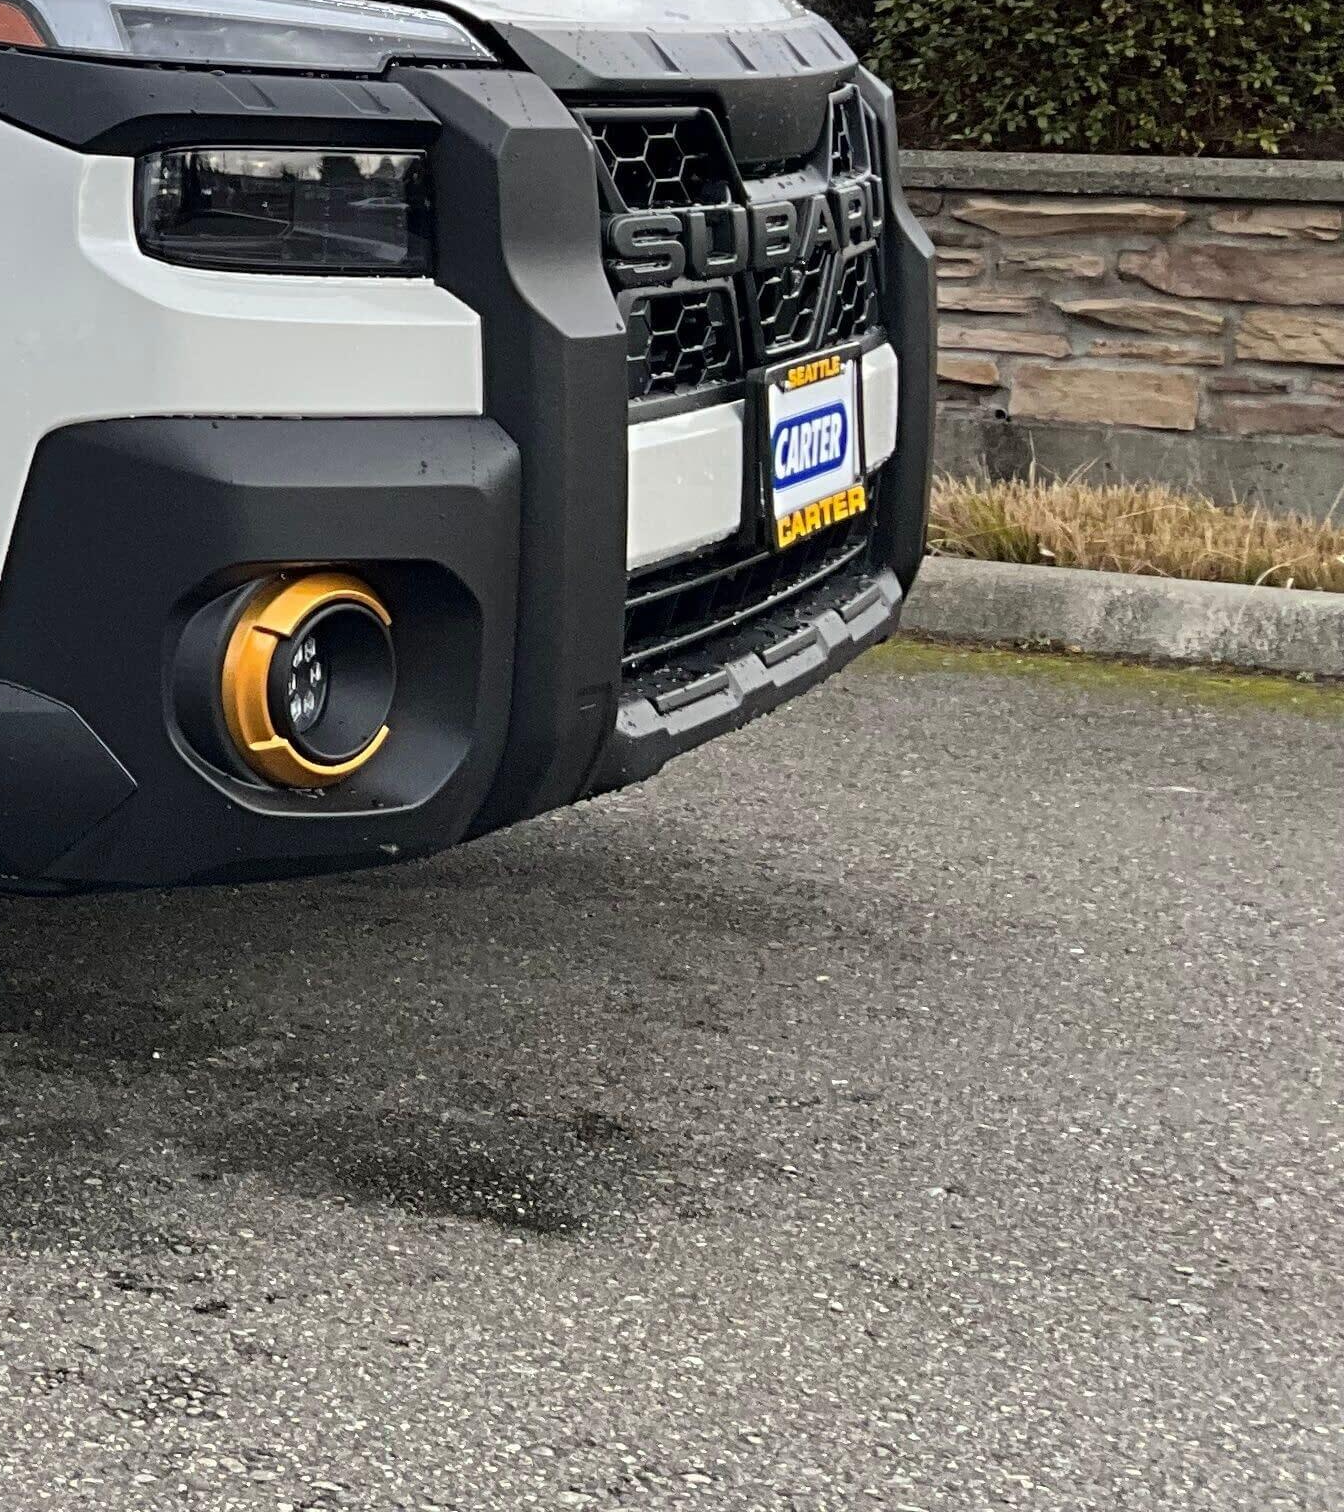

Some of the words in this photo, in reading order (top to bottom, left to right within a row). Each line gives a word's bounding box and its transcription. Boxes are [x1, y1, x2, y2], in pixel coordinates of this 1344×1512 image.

[788, 355, 841, 388] SEATTLE
[775, 411, 843, 480] CARTER
[777, 485, 867, 549] CARTER
